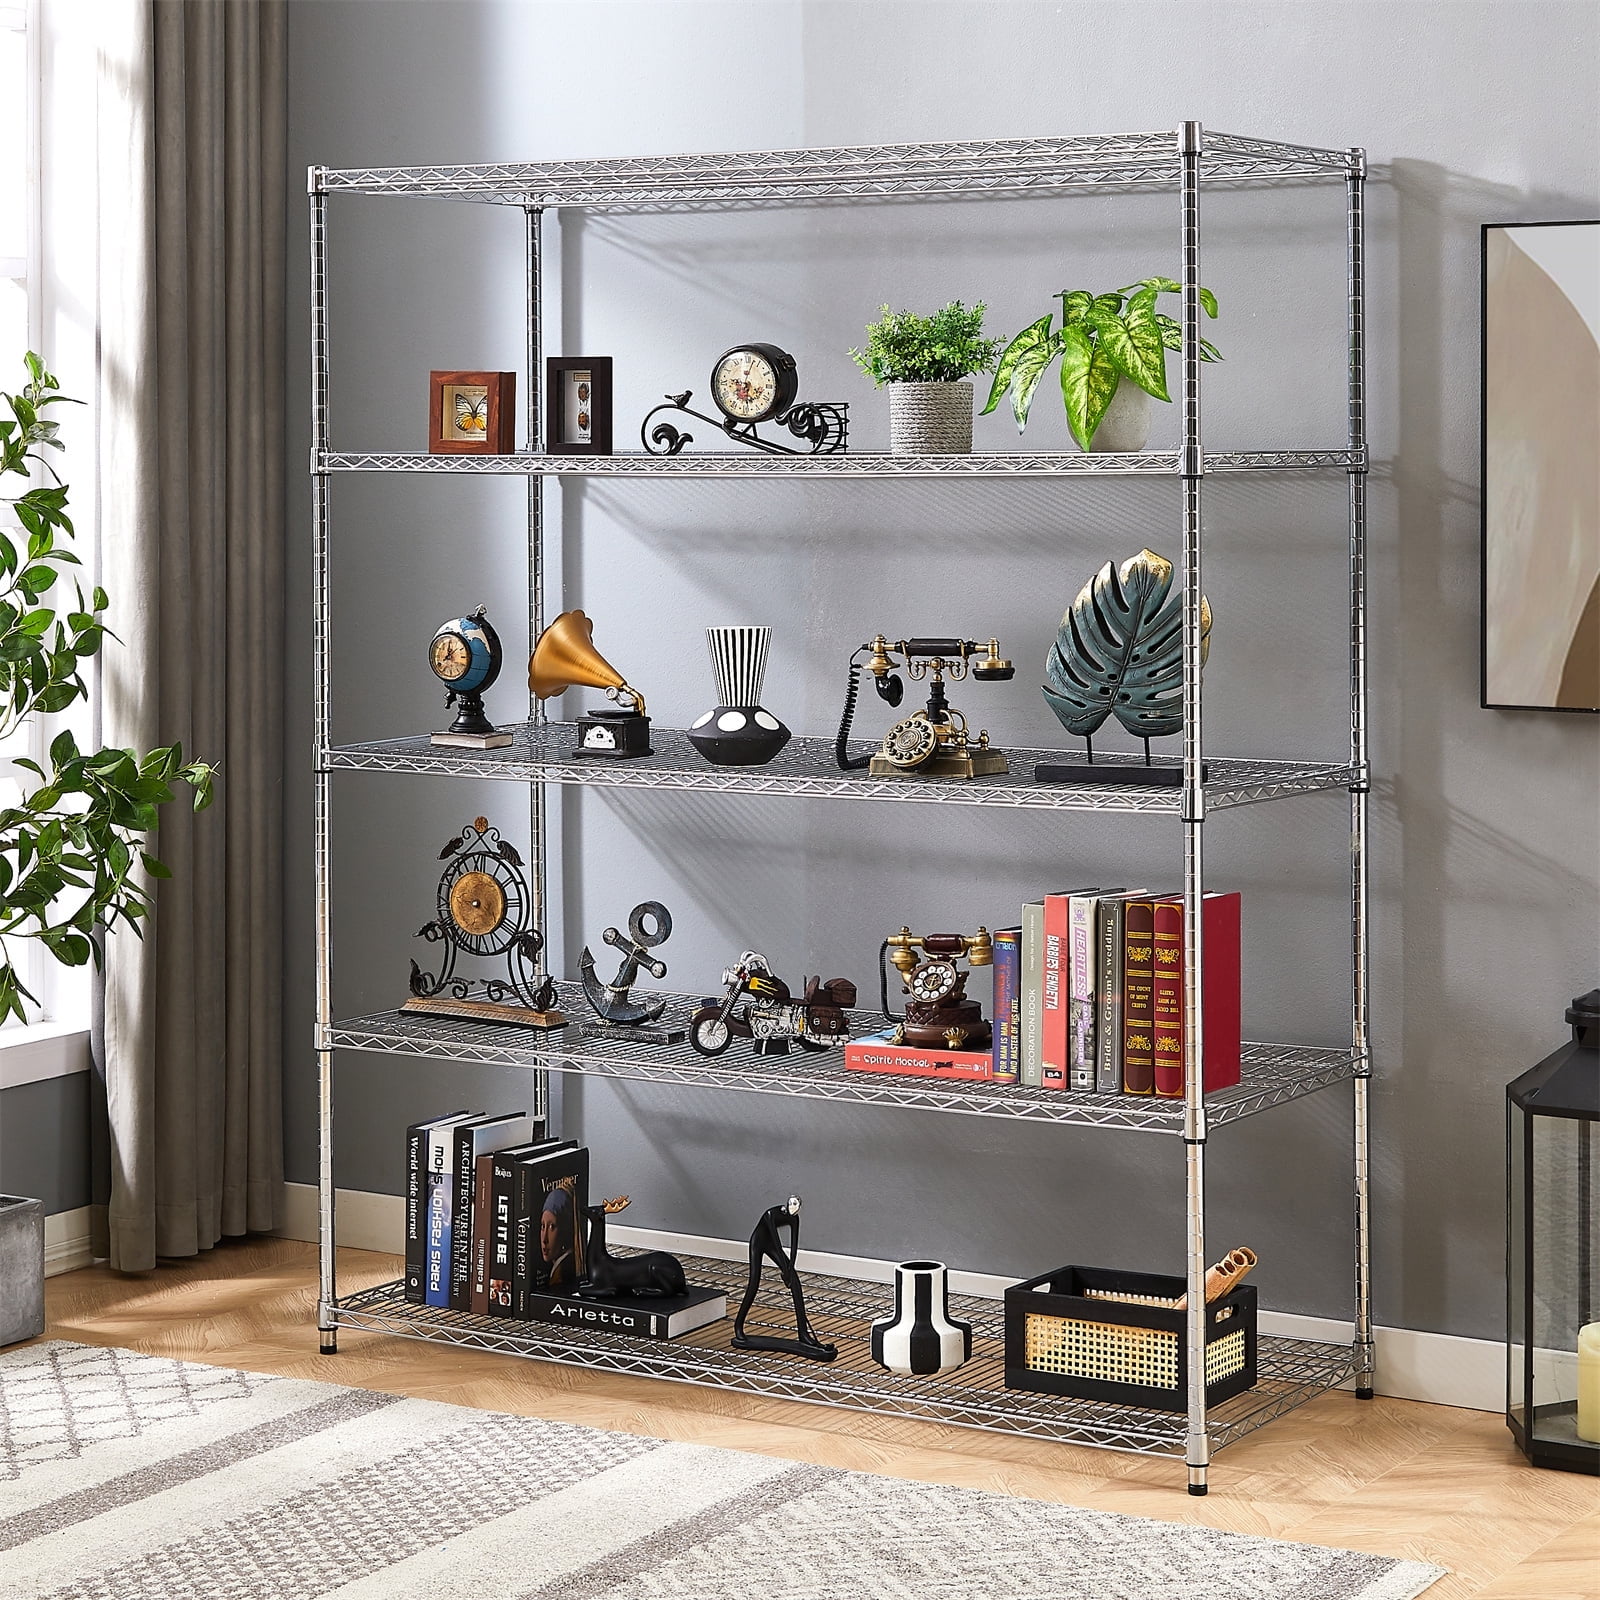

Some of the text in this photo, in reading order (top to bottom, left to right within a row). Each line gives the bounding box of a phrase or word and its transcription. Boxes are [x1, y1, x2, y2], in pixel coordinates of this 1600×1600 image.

[1076, 930, 1087, 997] HEARTLESS
[1045, 970, 1059, 1010] VENDETTA
[1103, 919, 1114, 1072] Bride & Groom's wedding
[1000, 1021, 1009, 1036] MAN
[1011, 1013, 1019, 1025] HIS
[1011, 1025, 1019, 1035] OF
[1000, 1036, 1008, 1044] IS
[1027, 988, 1036, 1078] DECORATION BOOK
[999, 1044, 1008, 1060] MAN
[1010, 1034, 1018, 1060] MASTER
[863, 1054, 893, 1065] Spirit
[999, 1060, 1008, 1073] FOR
[1010, 1060, 1018, 1074] AND
[409, 1136, 419, 1240] World wide internet
[540, 1173, 579, 1194] Vermeer
[496, 1195, 509, 1265] LET IT BE
[459, 1239, 468, 1254] IN
[516, 1216, 530, 1280] Vermeer
[452, 1261, 460, 1298] CENTURY
[459, 1255, 469, 1282] THE
[550, 1303, 635, 1327] Arletta
